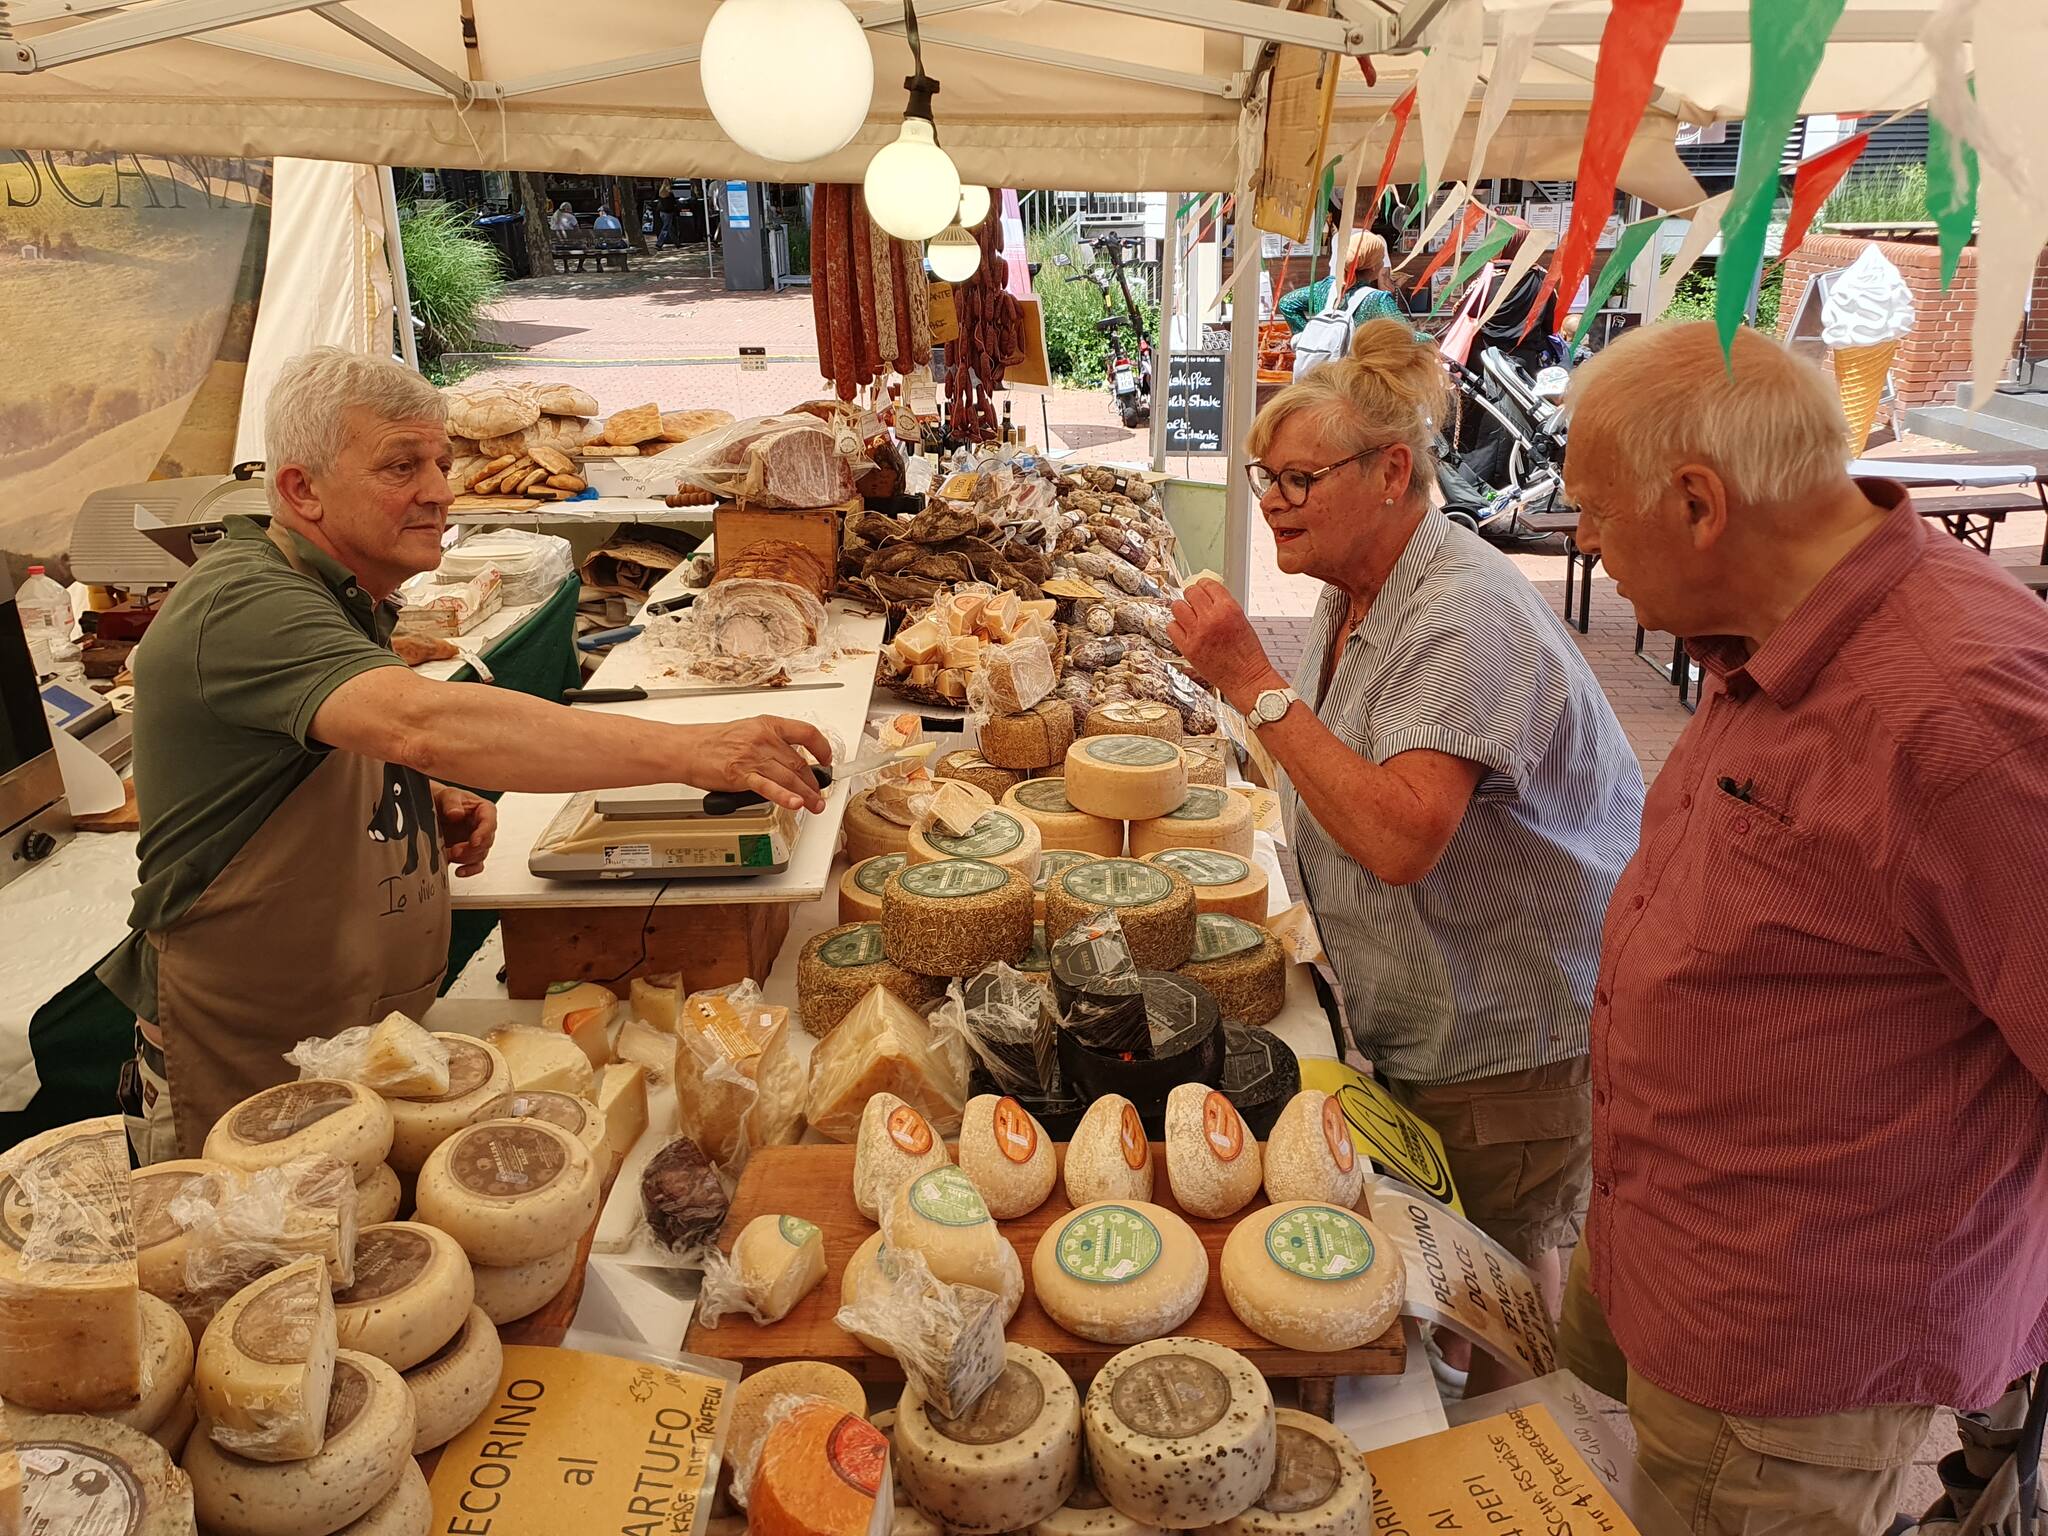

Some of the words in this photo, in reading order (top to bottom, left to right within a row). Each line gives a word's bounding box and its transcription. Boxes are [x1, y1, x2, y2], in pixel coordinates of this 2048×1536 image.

[1408, 1204, 1456, 1309] PECORINO
[1455, 1240, 1488, 1311] DOLCE
[1483, 1252, 1522, 1335] TENERO
[690, 1384, 723, 1445] TRÜFFELN
[447, 1377, 546, 1536] ECORINO
[558, 1456, 599, 1487] al
[621, 1407, 692, 1536] ARTUFO
[684, 1443, 708, 1477] MIT
[669, 1491, 697, 1534] KÄSE
[1462, 1473, 1514, 1525] PEPI
